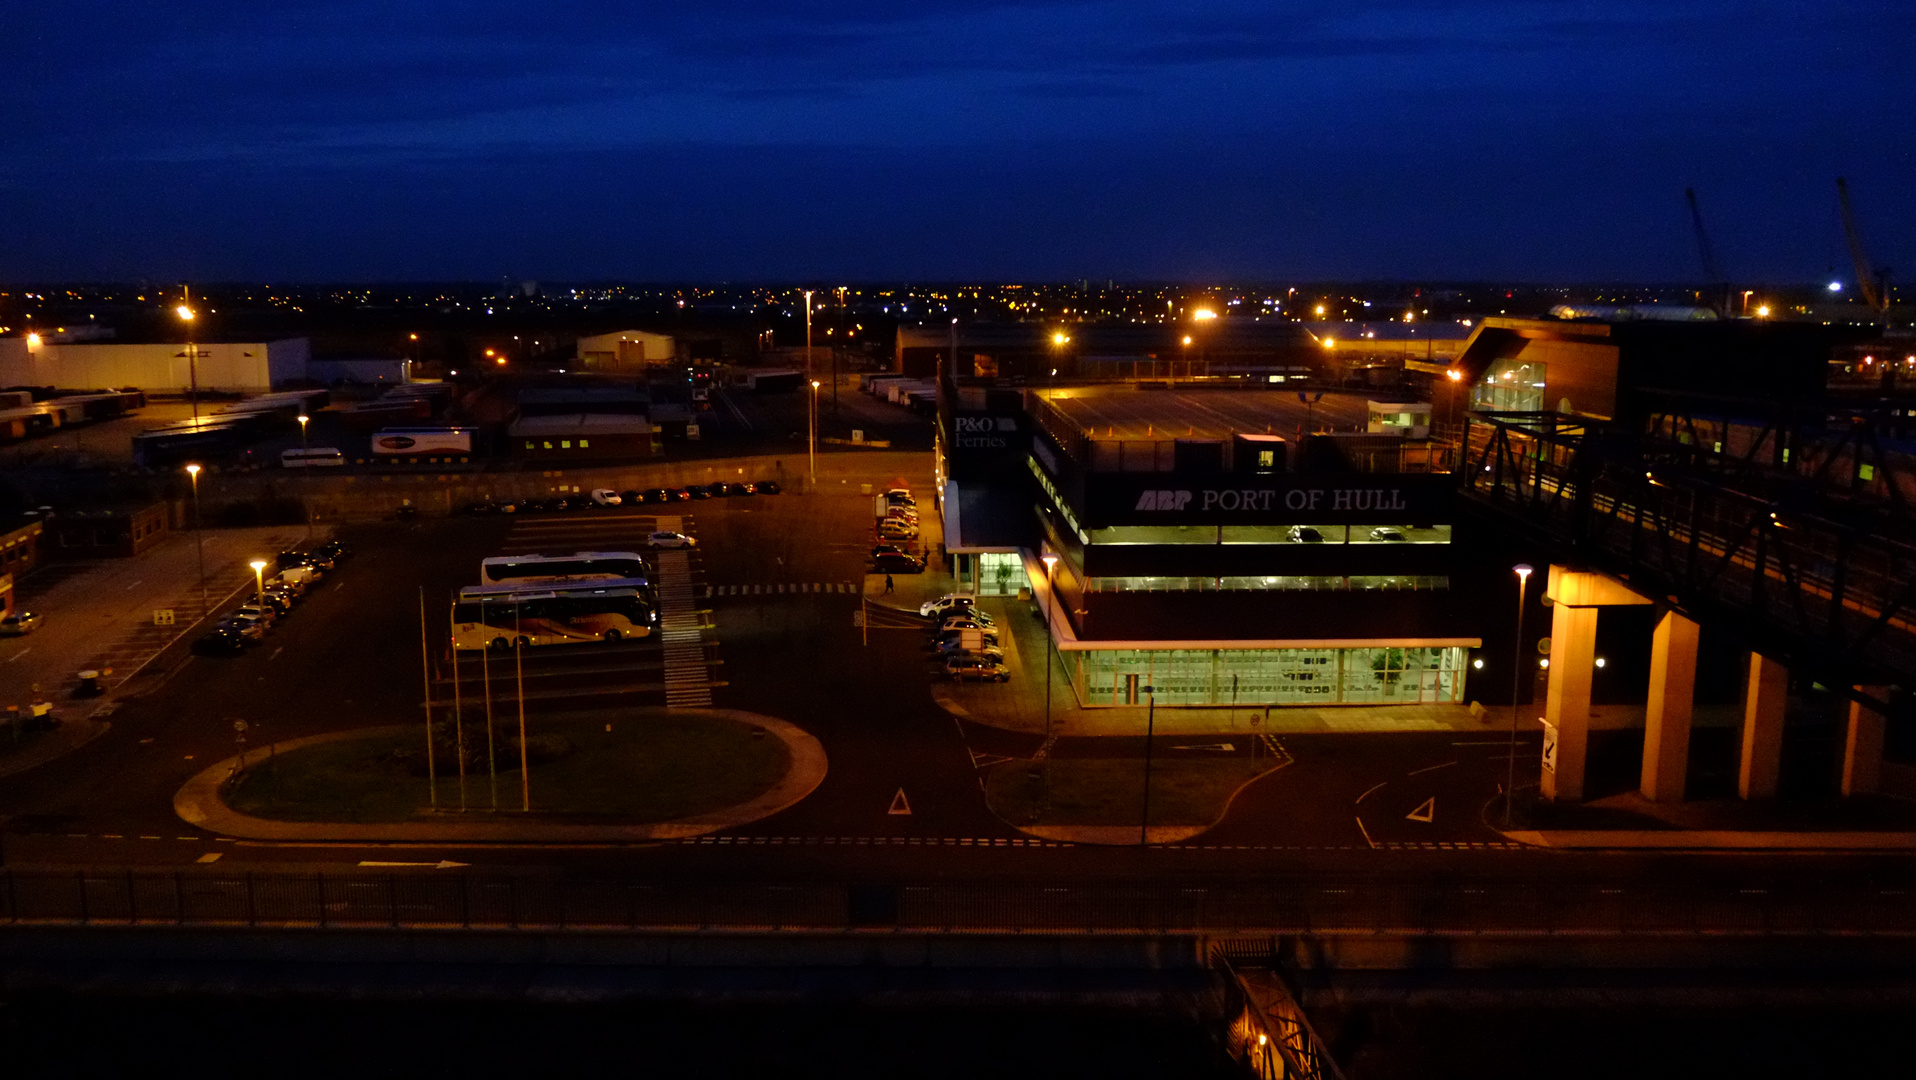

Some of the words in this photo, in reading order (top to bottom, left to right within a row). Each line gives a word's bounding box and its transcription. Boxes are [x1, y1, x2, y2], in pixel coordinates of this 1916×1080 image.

[954, 416, 994, 433] P&O
[954, 432, 1007, 448] Ferries
[1134, 489, 1193, 511] ABP
[1201, 489, 1276, 511] PORT
[1285, 489, 1325, 511] OF
[1332, 489, 1406, 511] HULL
